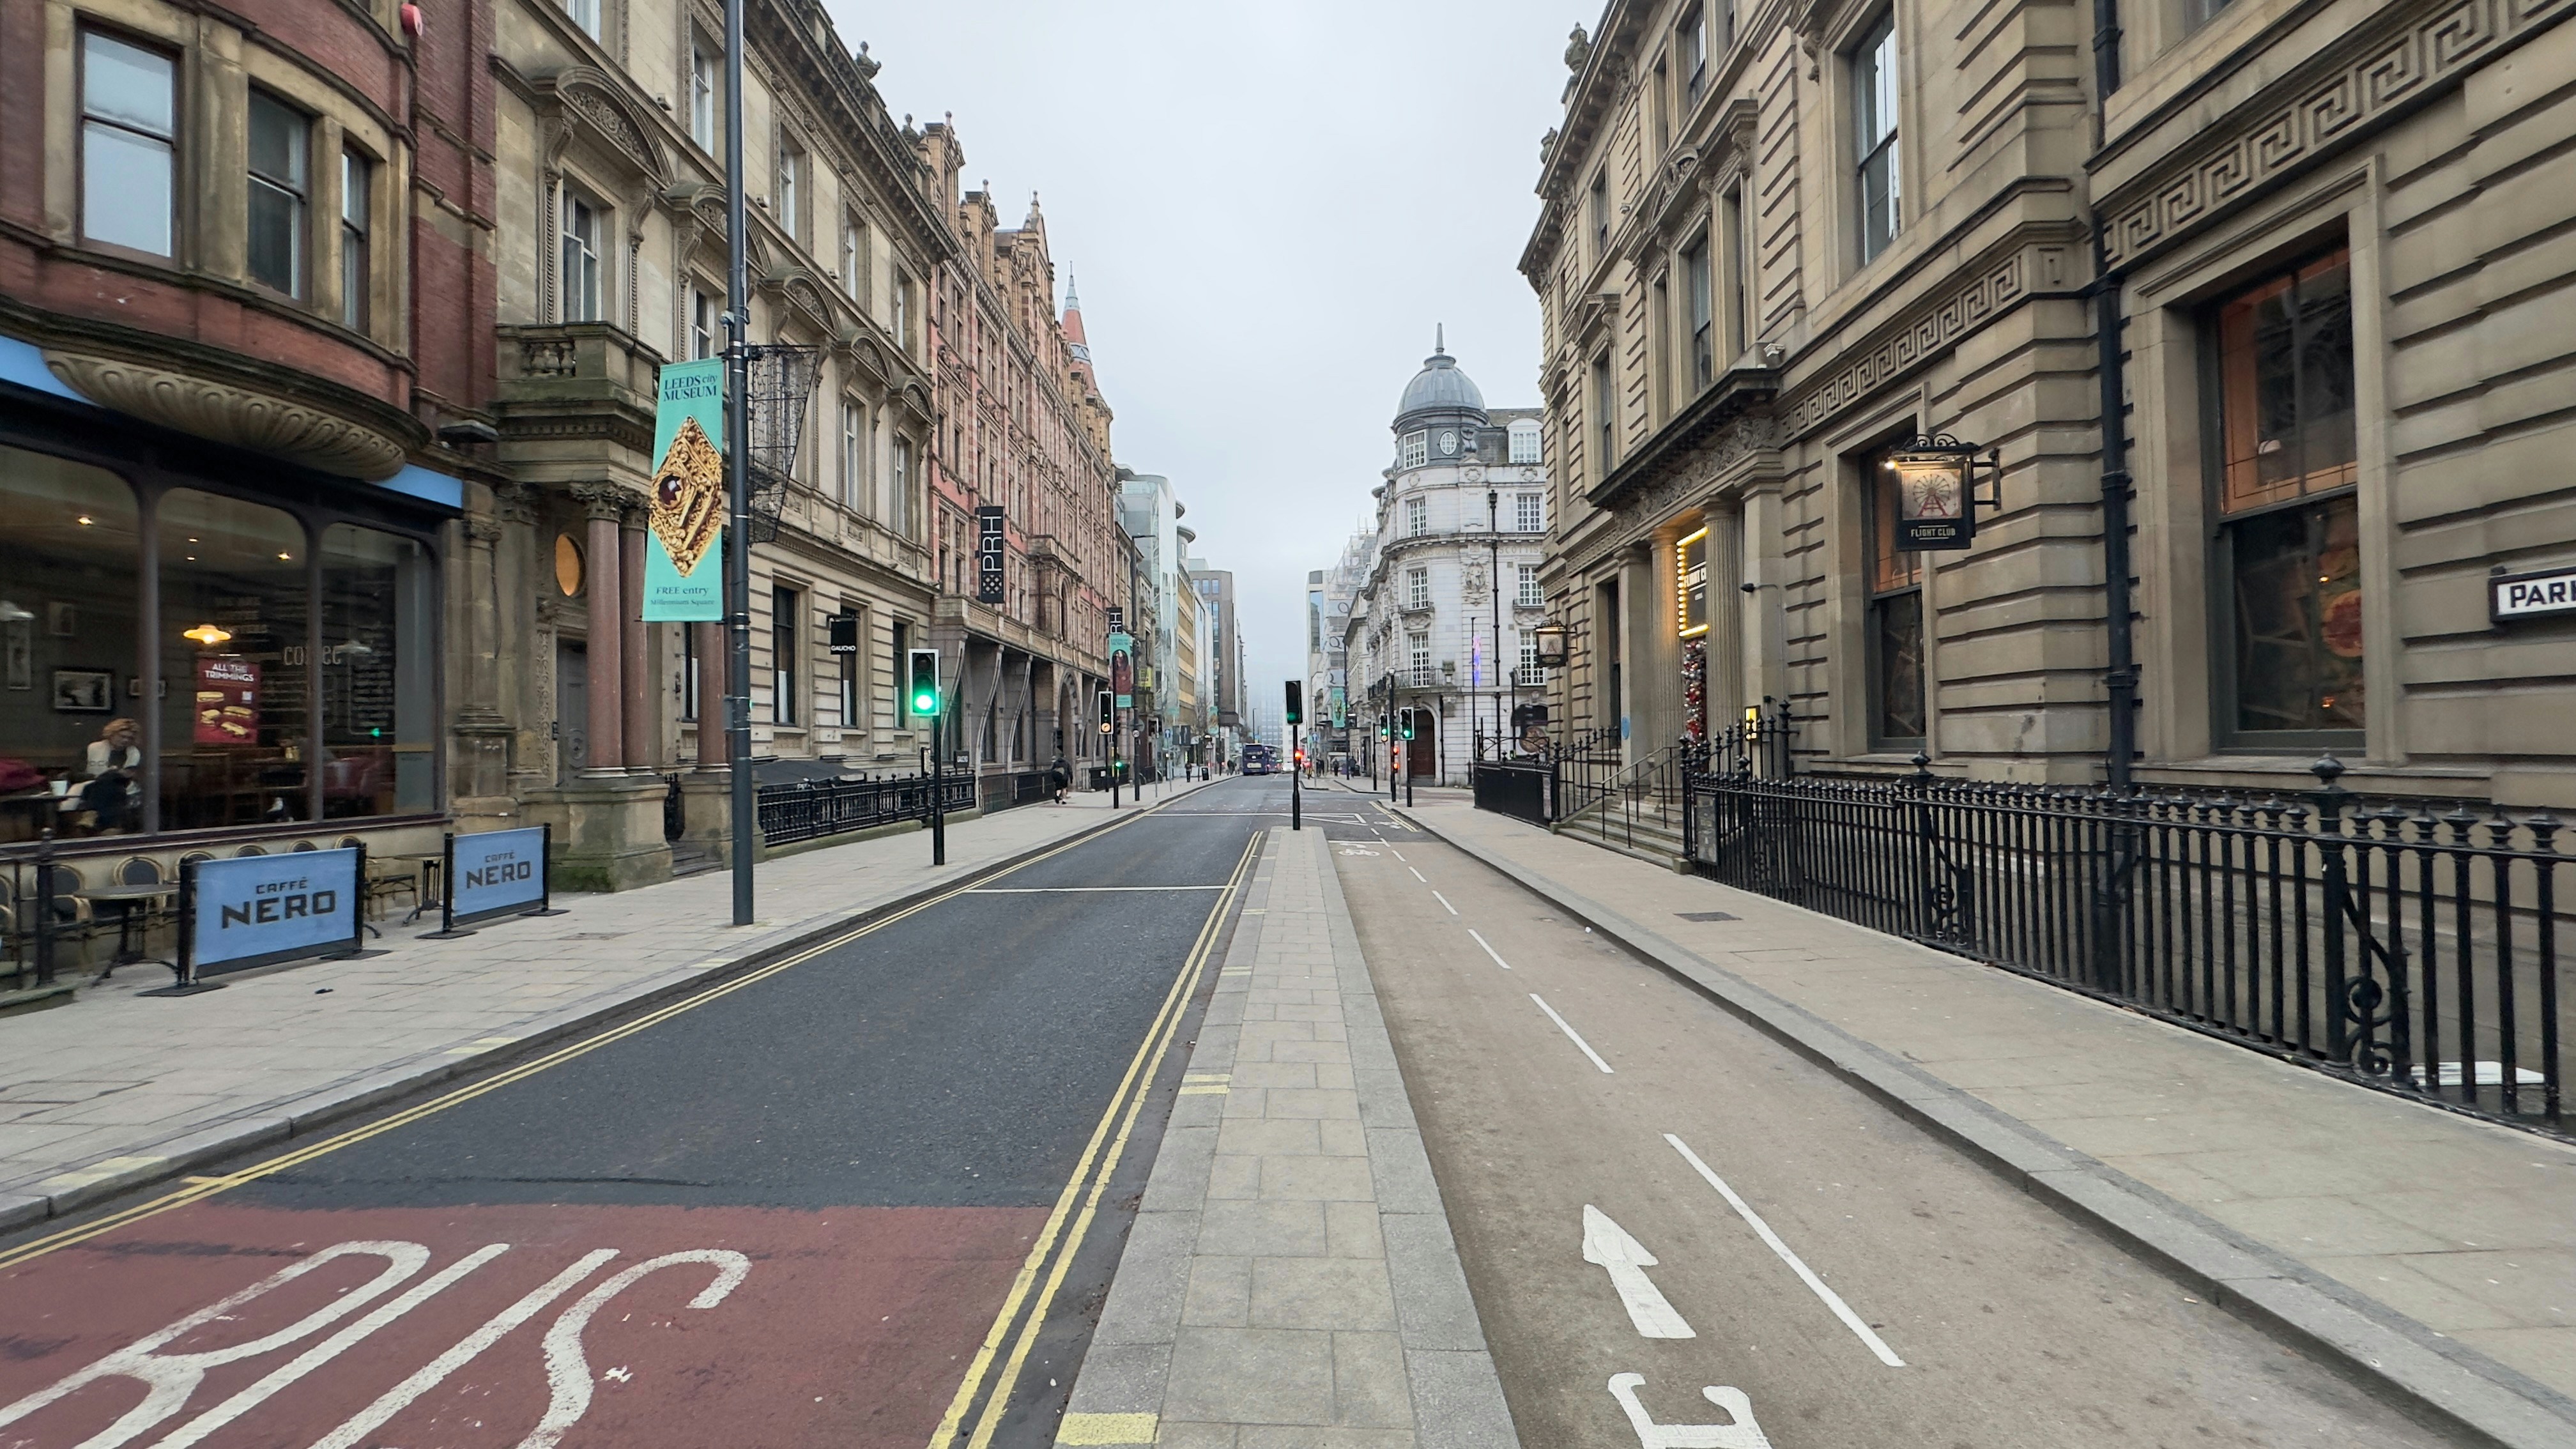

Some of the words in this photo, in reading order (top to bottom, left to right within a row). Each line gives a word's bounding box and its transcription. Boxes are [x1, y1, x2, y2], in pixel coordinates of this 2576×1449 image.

[664, 375, 701, 390] LEEDS
[702, 374, 717, 385] city
[664, 385, 717, 402] MUSEUM
[1910, 528, 1936, 537] FLIGHT
[1938, 528, 1956, 536] CLUB
[982, 516, 1002, 572] PRH
[656, 586, 680, 595] FREE
[682, 587, 708, 597] entry
[204, 670, 255, 682] TRIMMINGS
[211, 663, 227, 671] ALL
[230, 663, 248, 673] THE
[466, 861, 531, 889] NERO
[222, 889, 336, 929] NERO
